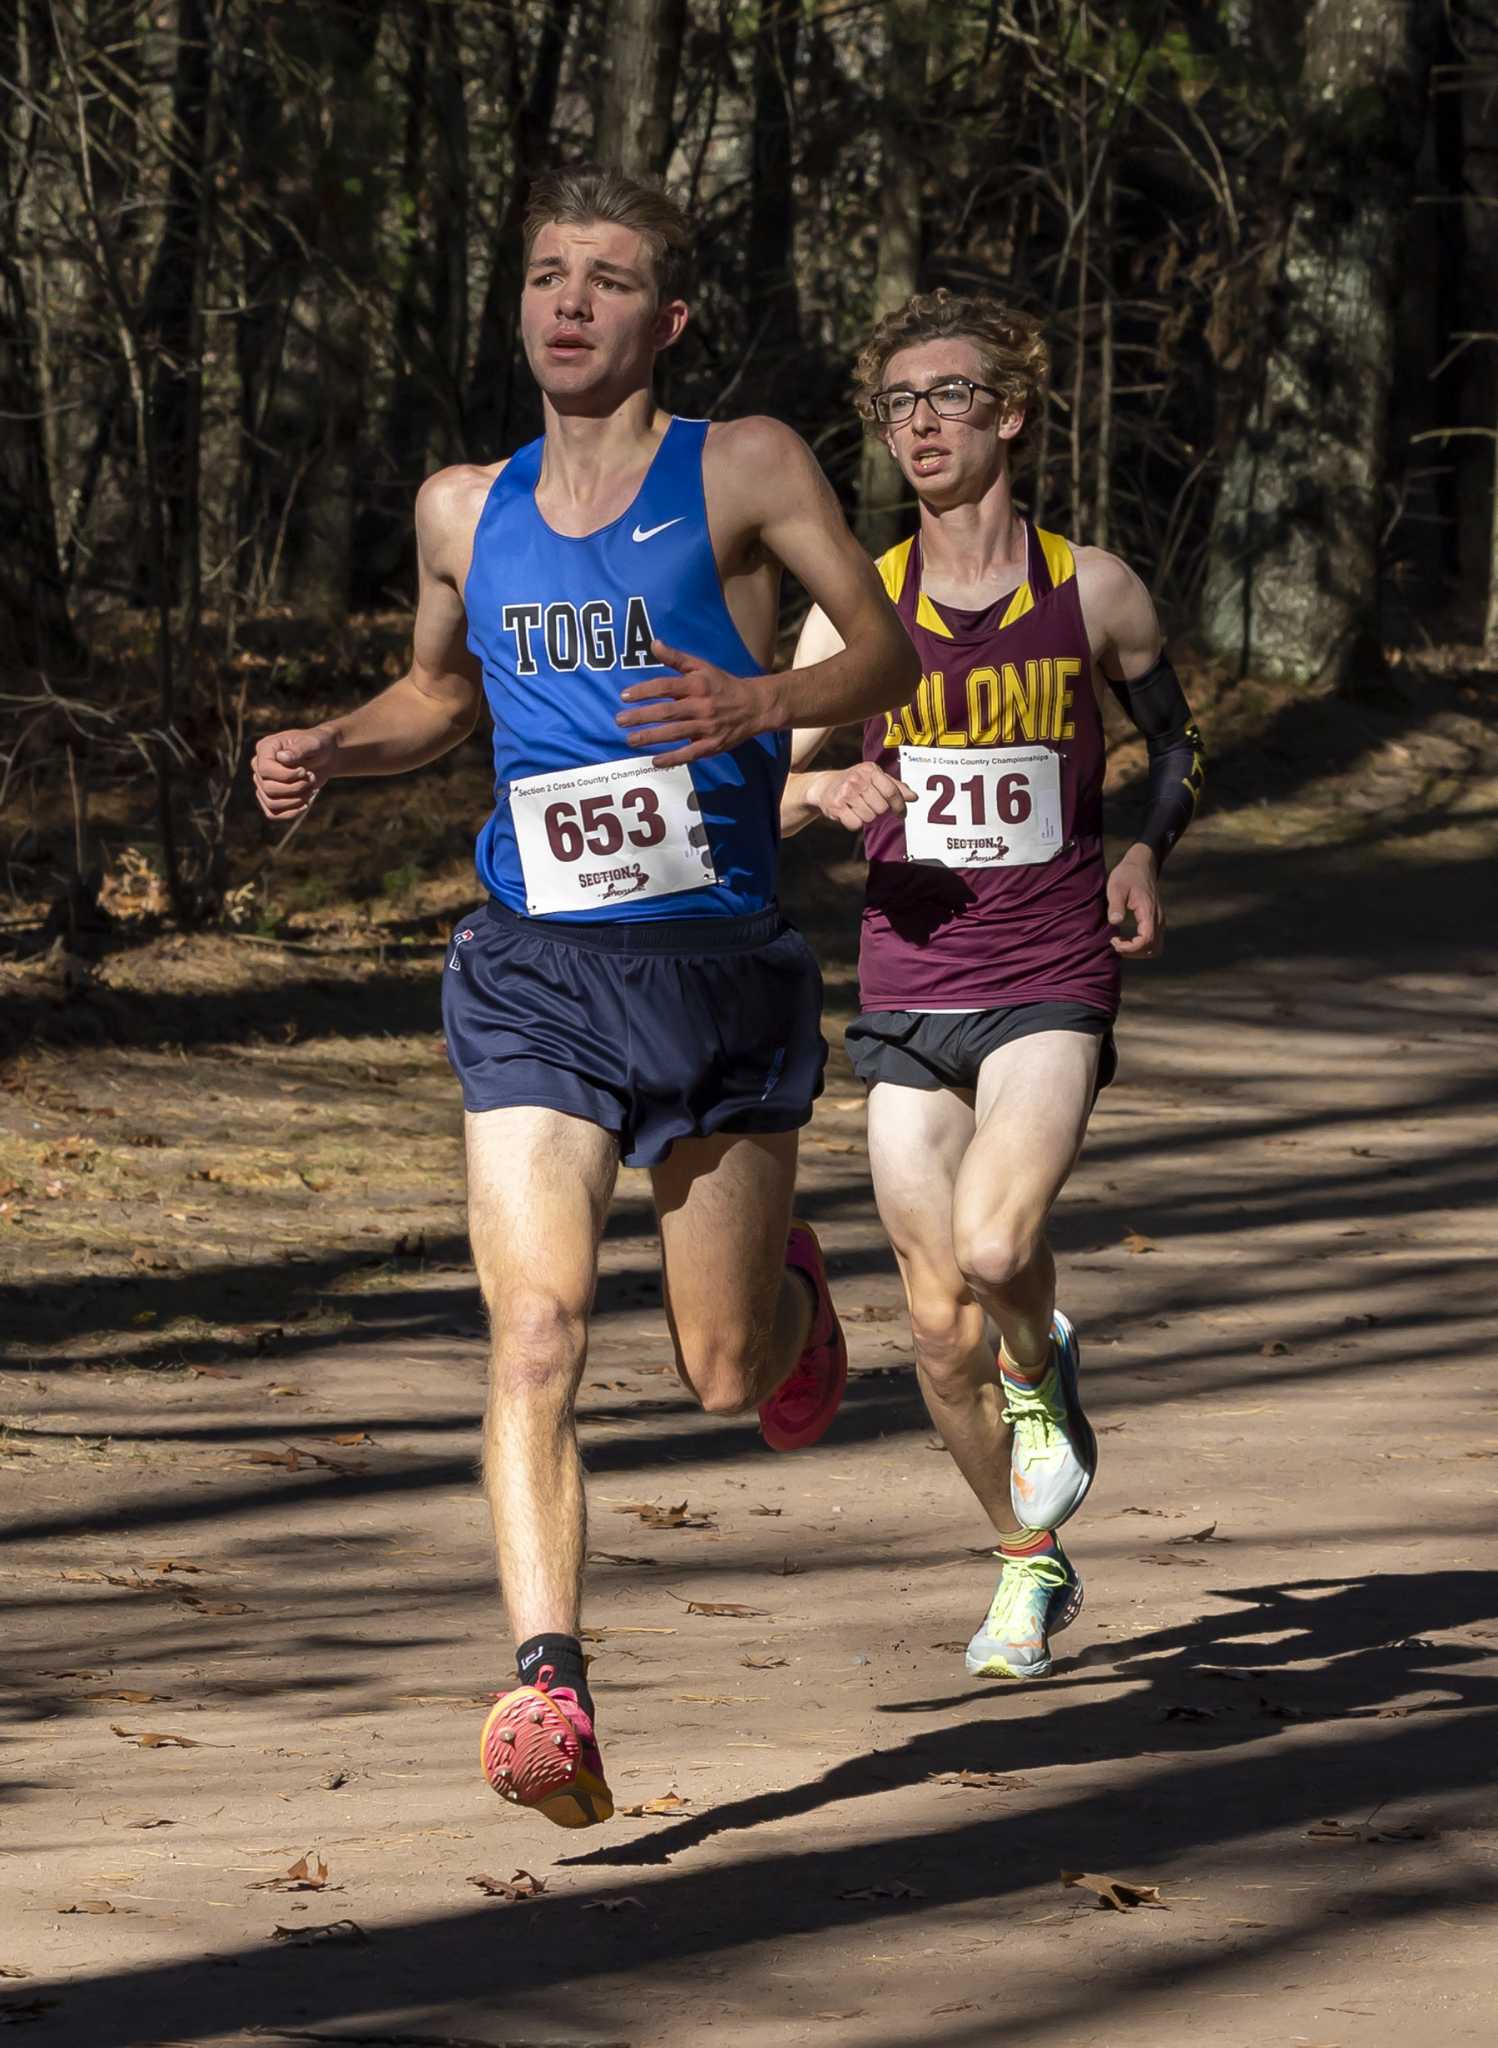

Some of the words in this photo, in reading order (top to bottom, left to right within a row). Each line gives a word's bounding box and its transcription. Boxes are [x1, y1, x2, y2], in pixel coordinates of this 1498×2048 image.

[502, 596, 665, 676] TOGA
[908, 755, 931, 763] Section
[960, 757, 989, 767] Country
[991, 754, 1049, 765] Championships
[517, 785, 546, 798] Section
[546, 784, 552, 792] 2
[552, 781, 575, 792] Cross
[576, 775, 609, 787] Country
[926, 773, 1032, 826] 216
[544, 787, 667, 863] 653
[946, 837, 994, 850] SECTION
[578, 866, 631, 889] SECTION
